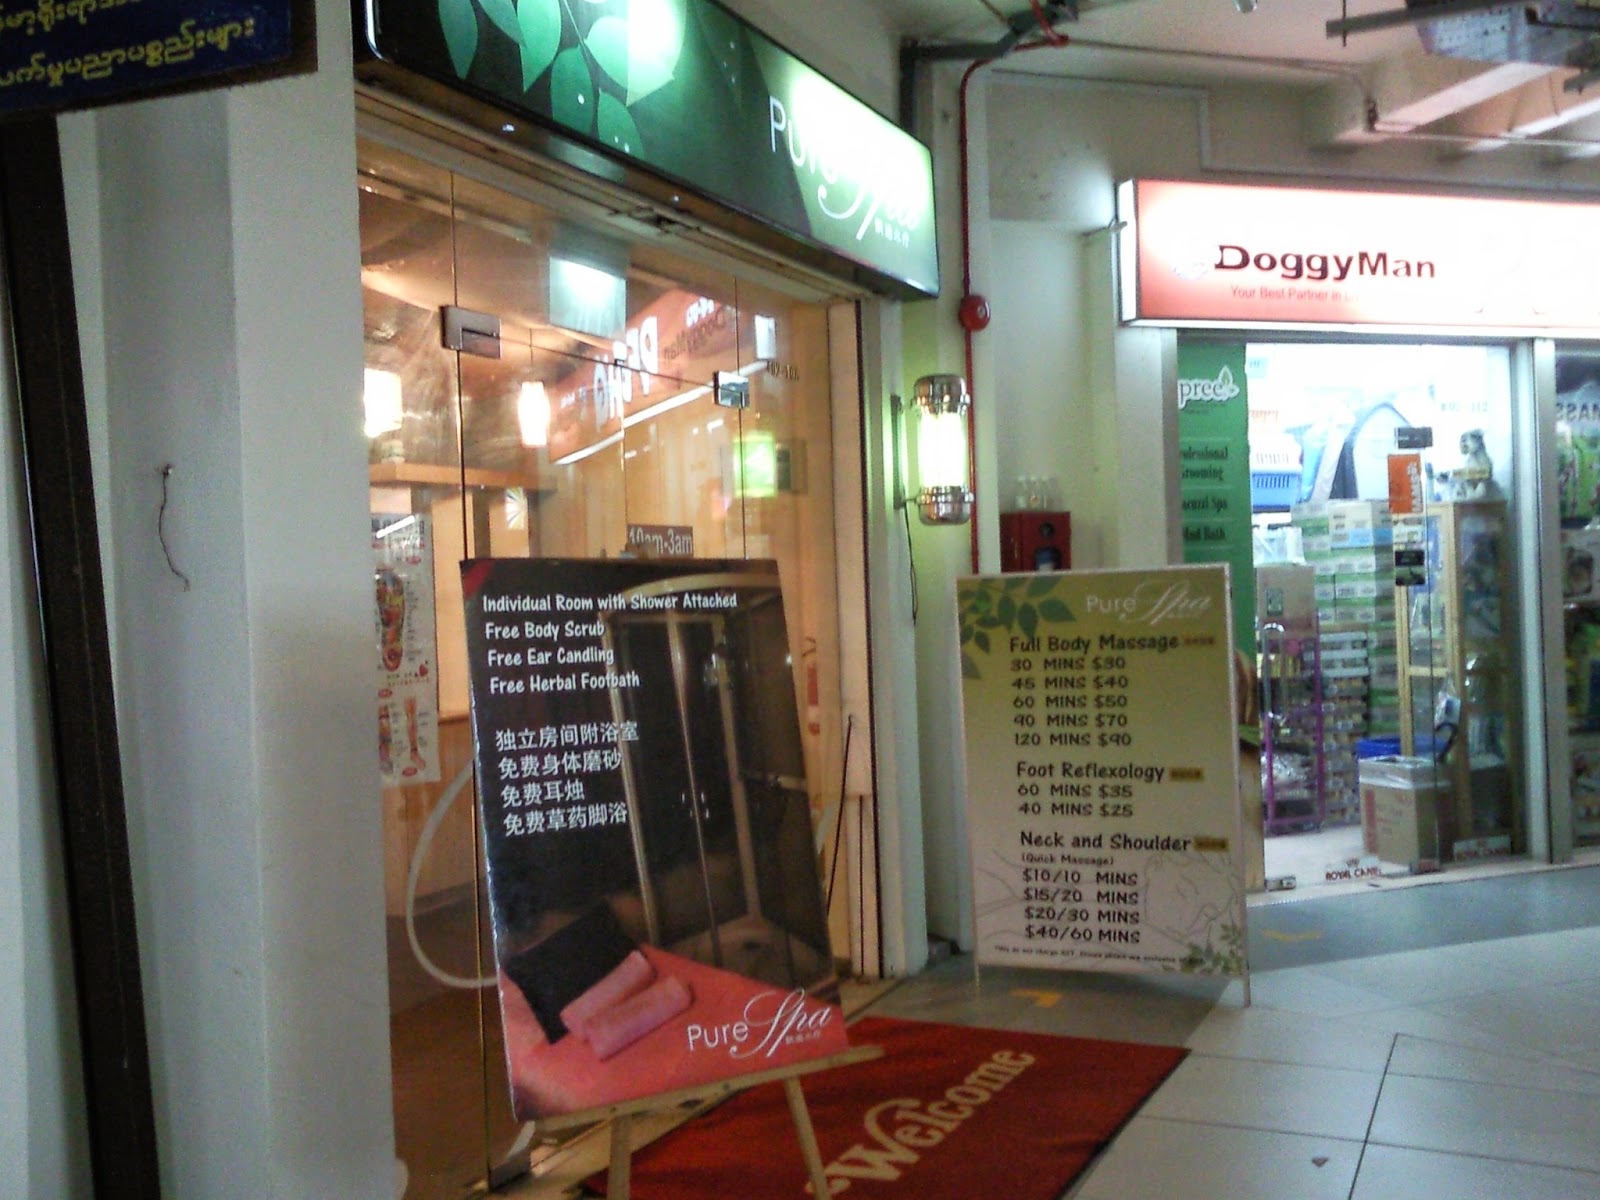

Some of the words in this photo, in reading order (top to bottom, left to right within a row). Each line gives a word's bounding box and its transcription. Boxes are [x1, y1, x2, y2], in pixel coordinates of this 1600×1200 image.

[1214, 244, 1436, 282] DoggyMan
[1230, 285, 1256, 298] Your
[1260, 286, 1286, 299] Best
[1288, 287, 1329, 302] Partner
[483, 594, 551, 613] Individual
[556, 594, 594, 611] Room
[597, 594, 627, 611] with
[631, 593, 678, 610] Shower
[683, 592, 738, 609] Attached
[1087, 595, 1137, 614] Pure
[485, 622, 520, 640] Free
[525, 620, 559, 641] Body
[564, 619, 605, 638] Scrub
[1010, 636, 1041, 653] Full
[1048, 635, 1091, 655] Body
[1099, 633, 1179, 655] Massage
[487, 649, 522, 667] Free
[527, 648, 551, 665] Ear
[557, 646, 614, 666] Candling
[1010, 658, 1032, 672] 30
[1043, 656, 1085, 671] MINS
[1092, 656, 1126, 671] $30
[489, 676, 525, 695] Free
[530, 674, 577, 692] Herbal
[581, 671, 640, 690] Footbath
[1011, 677, 1035, 690] 45
[1044, 676, 1086, 690] MINS
[1093, 675, 1129, 690] $40
[1013, 696, 1035, 709] 60
[1045, 695, 1087, 709] MINS
[1094, 694, 1128, 709] $50
[1013, 714, 1035, 728] 90
[1046, 714, 1088, 728] MINS
[1095, 713, 1128, 728] $70
[495, 721, 640, 752] 独立房间附浴室
[1014, 733, 1041, 746] 120
[1050, 732, 1091, 746] MINS
[1097, 732, 1132, 748] $90
[498, 748, 623, 780] 免费身体磨砂
[1016, 760, 1054, 778] Foot
[1061, 763, 1165, 784] Reflexology
[500, 778, 585, 809] 免费耳烛
[1017, 784, 1040, 797] 60
[1050, 783, 1092, 798] MINS
[1099, 784, 1133, 799] $35
[503, 801, 629, 838] 免费草药脚浴
[1018, 802, 1041, 816] 40
[1051, 803, 1093, 817] MINS
[1099, 803, 1133, 818] $25
[1020, 830, 1065, 848] Neck
[1071, 831, 1103, 849] and
[1110, 834, 1192, 852] Shoulder
[1095, 872, 1138, 887] MINS
[1096, 891, 1139, 906] MINS
[1097, 909, 1140, 924] MINS
[1098, 929, 1140, 944] MINS
[687, 1022, 749, 1052] Pure
[729, 987, 832, 1058] Spa
[806, 1050, 1036, 1192] Welcome
